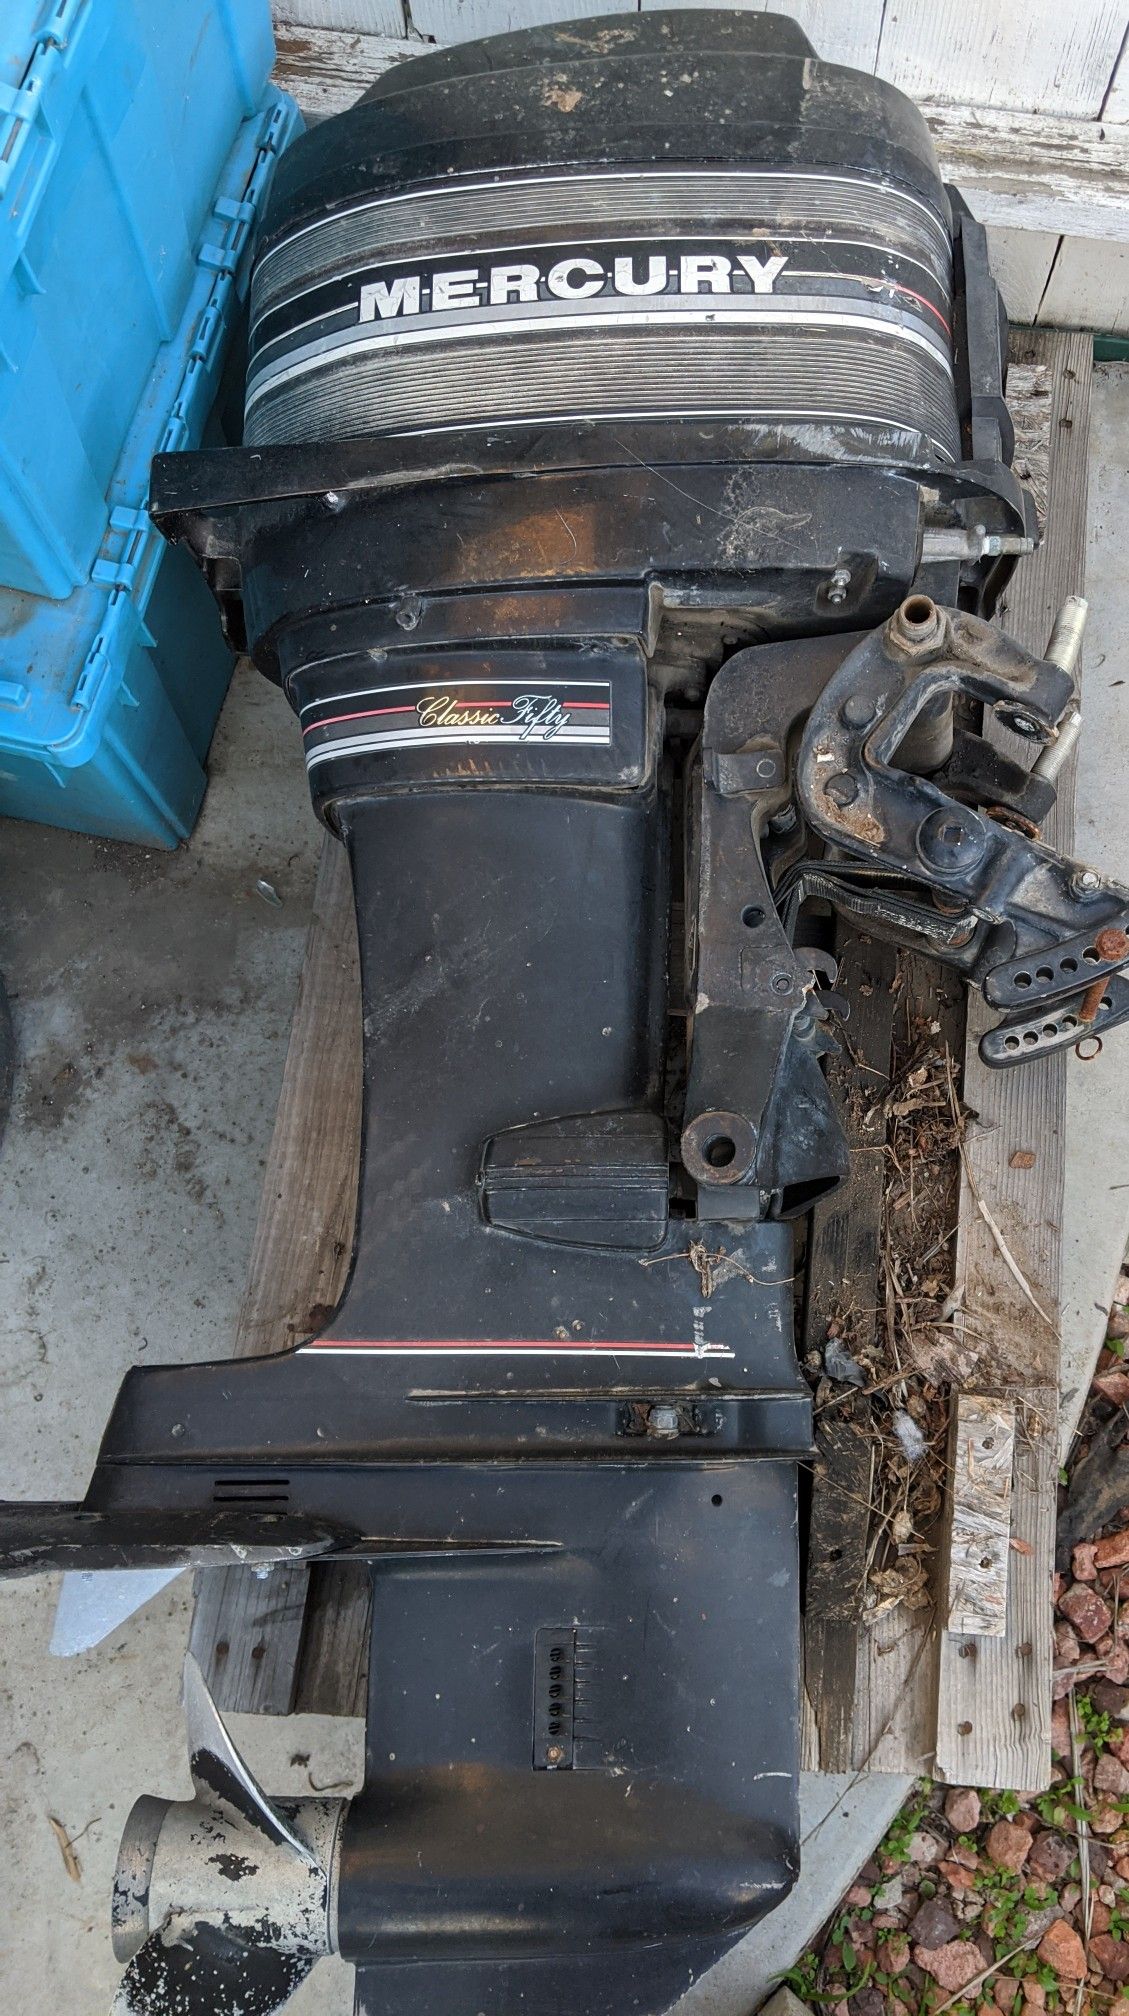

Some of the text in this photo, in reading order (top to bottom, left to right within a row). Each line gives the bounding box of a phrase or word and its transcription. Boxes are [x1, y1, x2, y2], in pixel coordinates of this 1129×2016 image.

[359, 255, 789, 322] MERCURY
[416, 694, 571, 740] Classic Fifty
